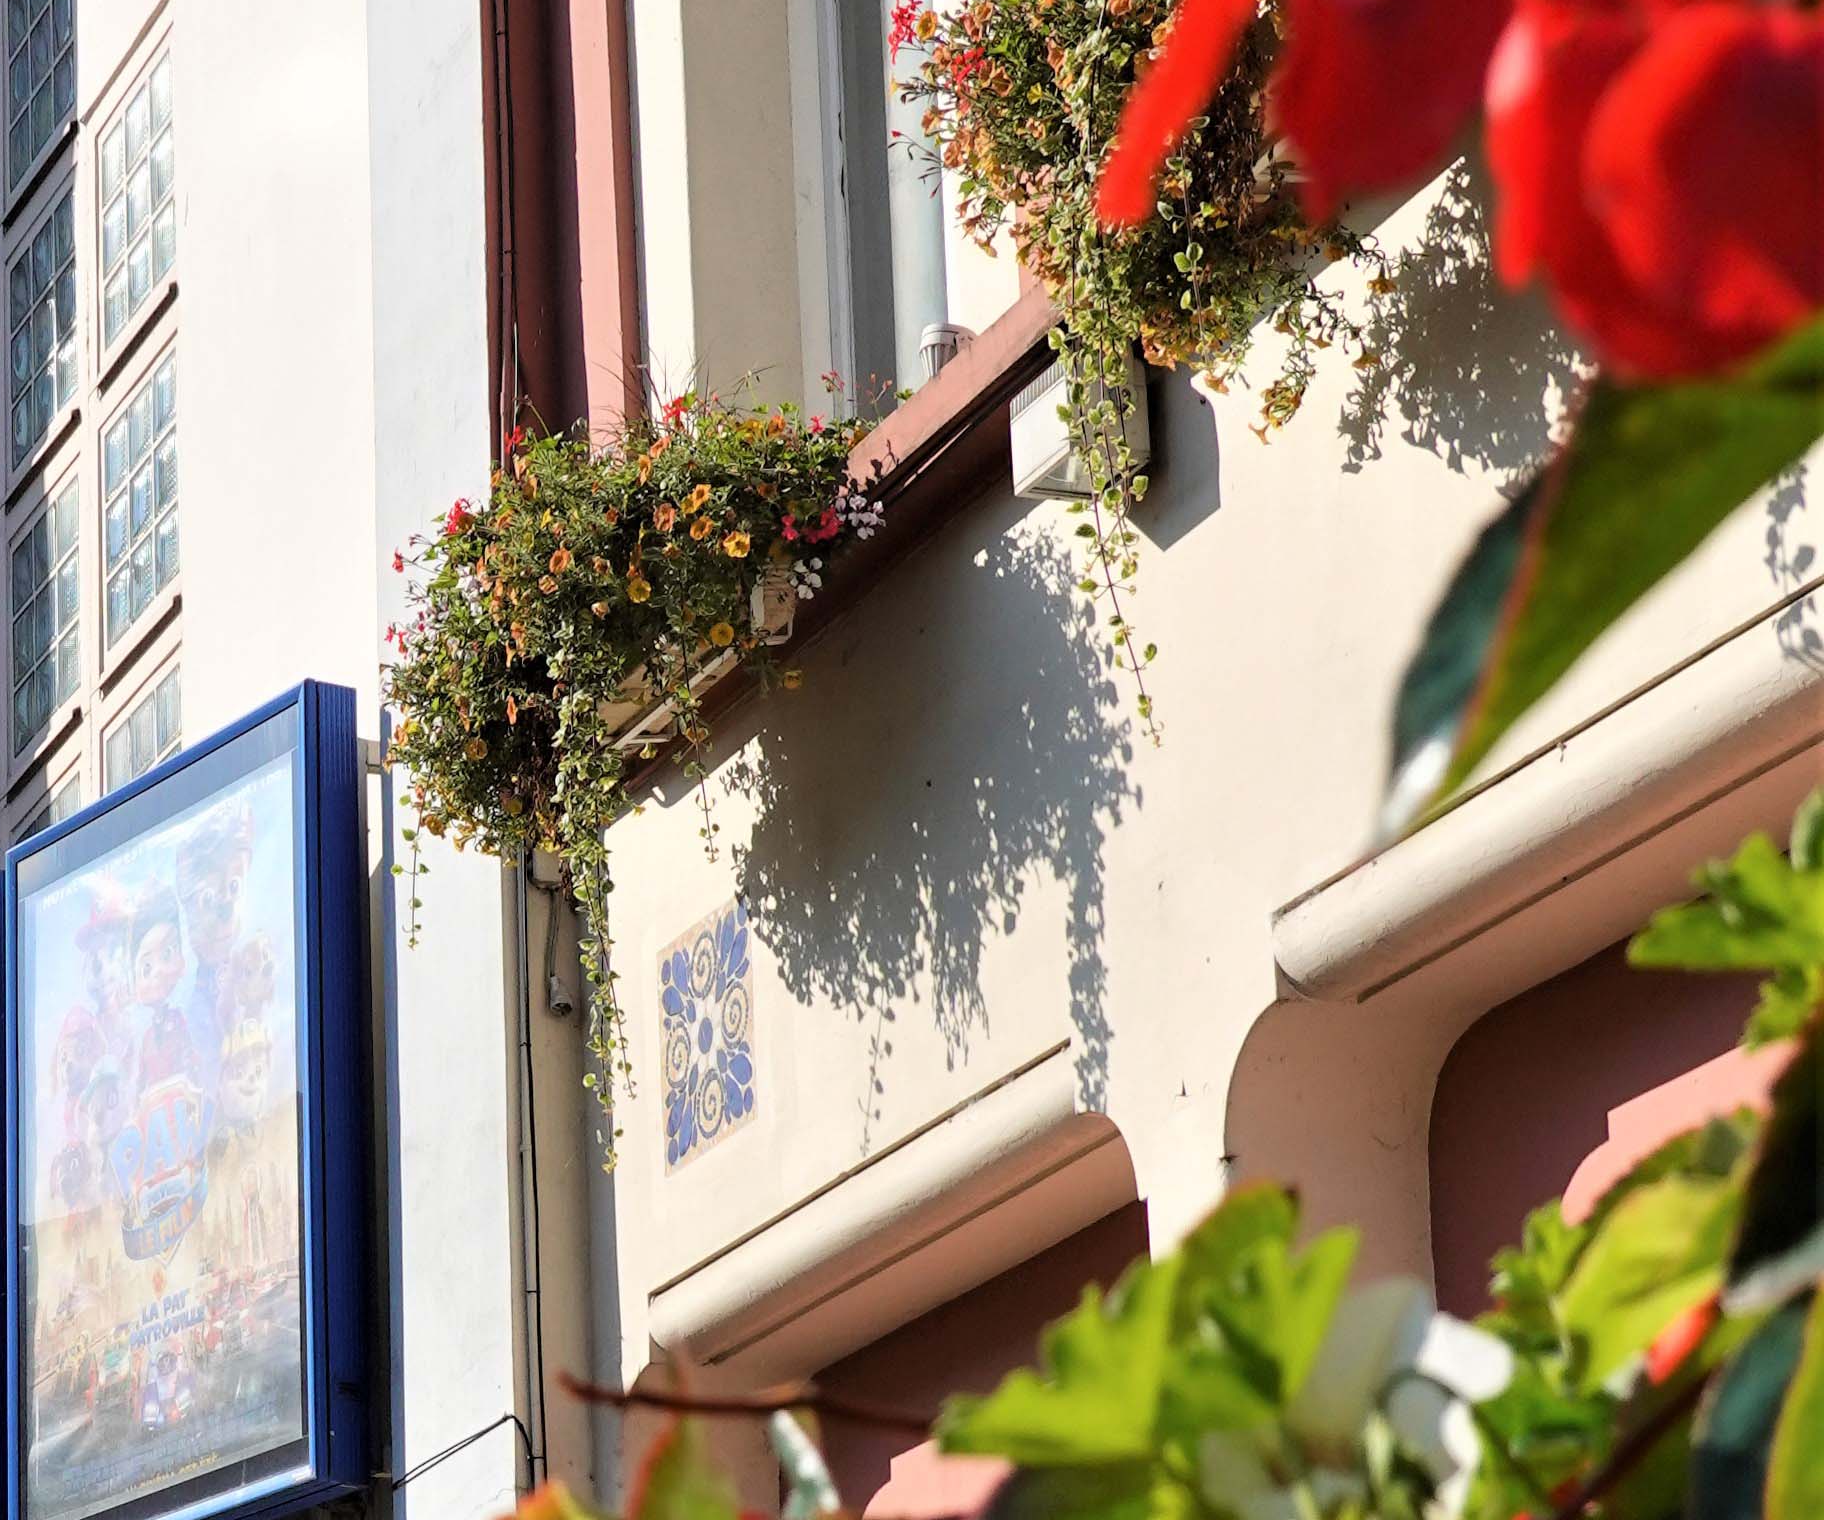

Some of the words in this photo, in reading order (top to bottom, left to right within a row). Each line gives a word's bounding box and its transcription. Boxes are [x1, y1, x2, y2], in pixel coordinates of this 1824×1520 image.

[111, 1096, 214, 1195] PAW
[142, 1301, 159, 1326] LA
[162, 1287, 189, 1317] PAT
